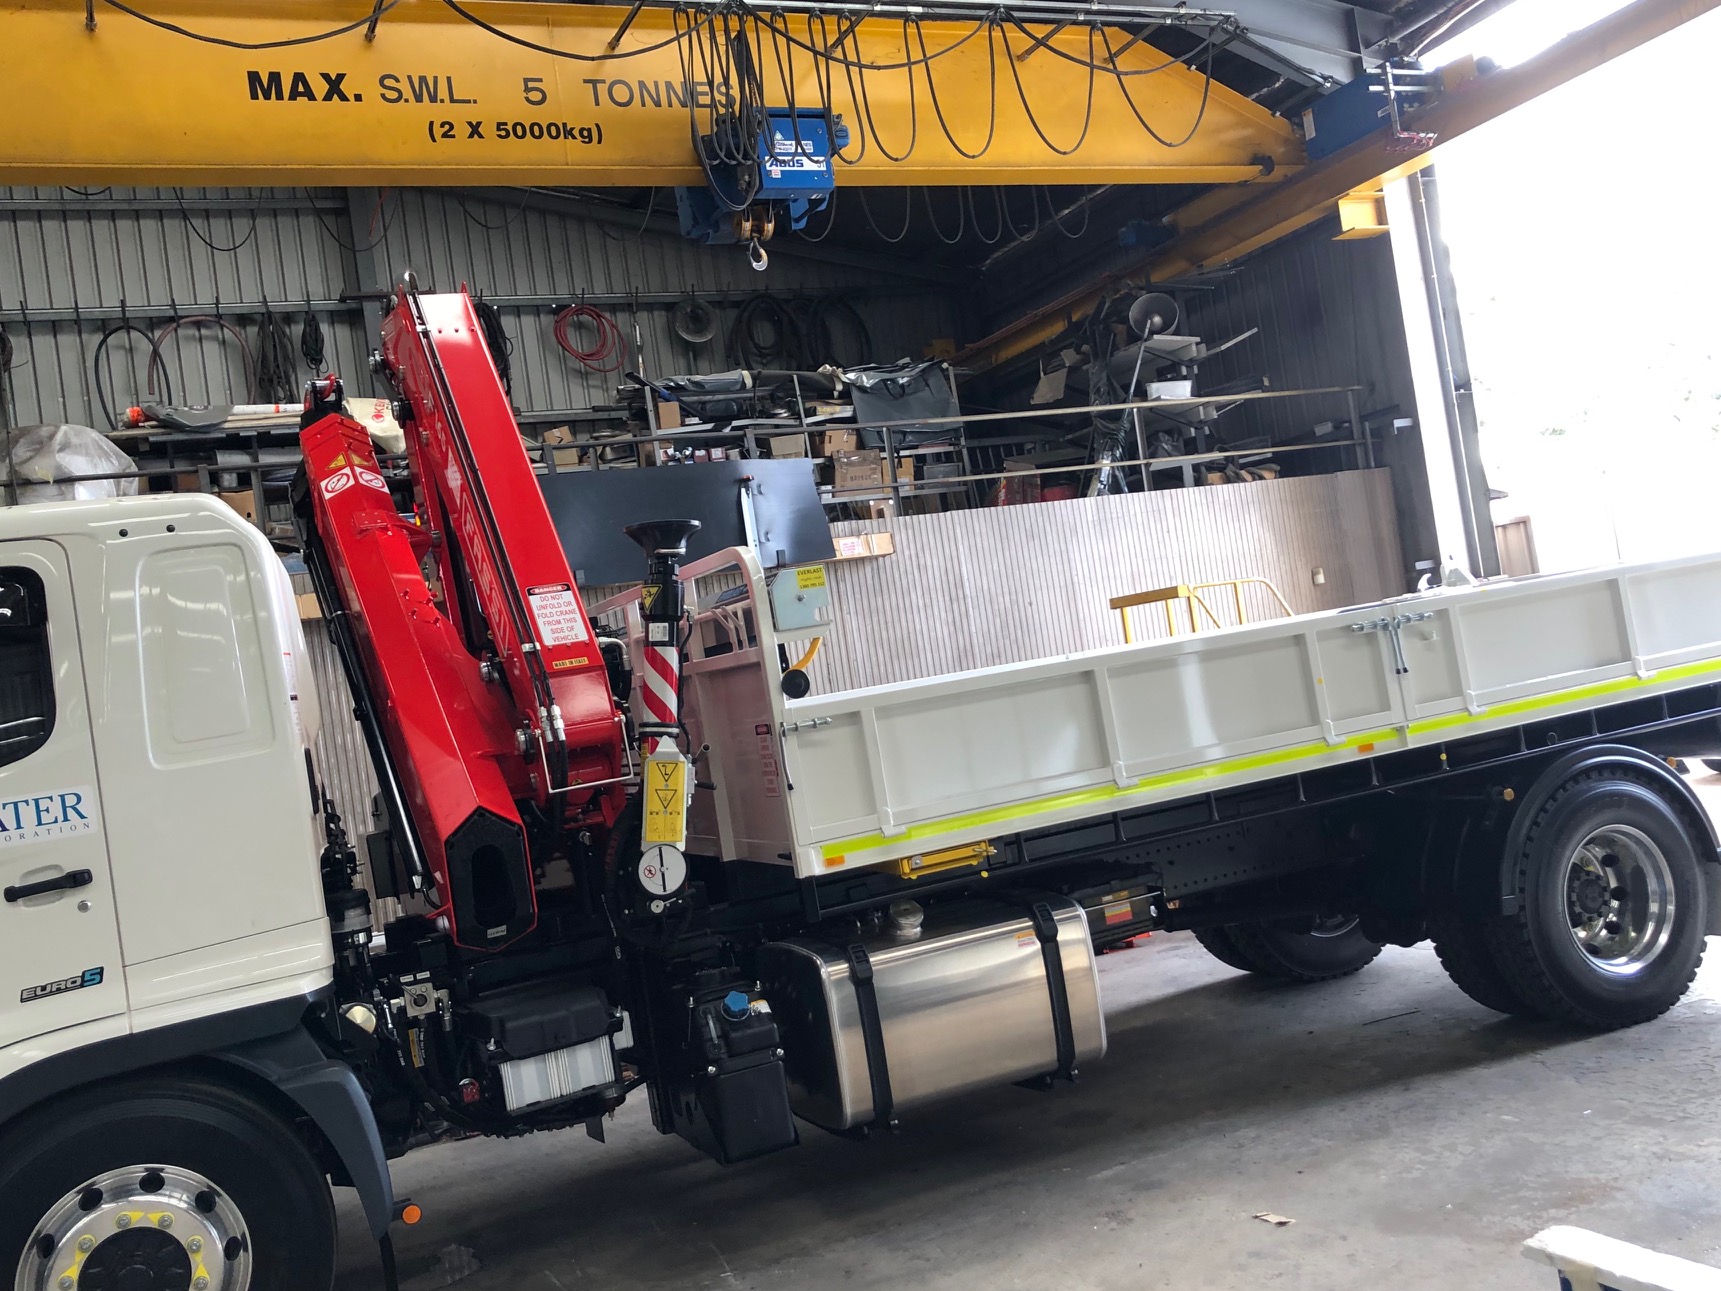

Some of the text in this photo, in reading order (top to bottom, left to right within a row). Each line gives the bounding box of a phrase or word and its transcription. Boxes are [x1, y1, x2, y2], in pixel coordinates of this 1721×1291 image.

[246, 70, 737, 109] MAX. S.W.L. 5 TONNES
[465, 120, 485, 139] X
[495, 121, 603, 144] 5000kg)
[797, 567, 822, 576] EVERLAST
[535, 585, 562, 593] DANGER
[536, 602, 562, 611] UNFOLD
[537, 609, 578, 619] FOLD CRANE
[543, 619, 562, 627] FROM
[550, 627, 565, 635] SIDE
[552, 633, 579, 642] VEHICLE
